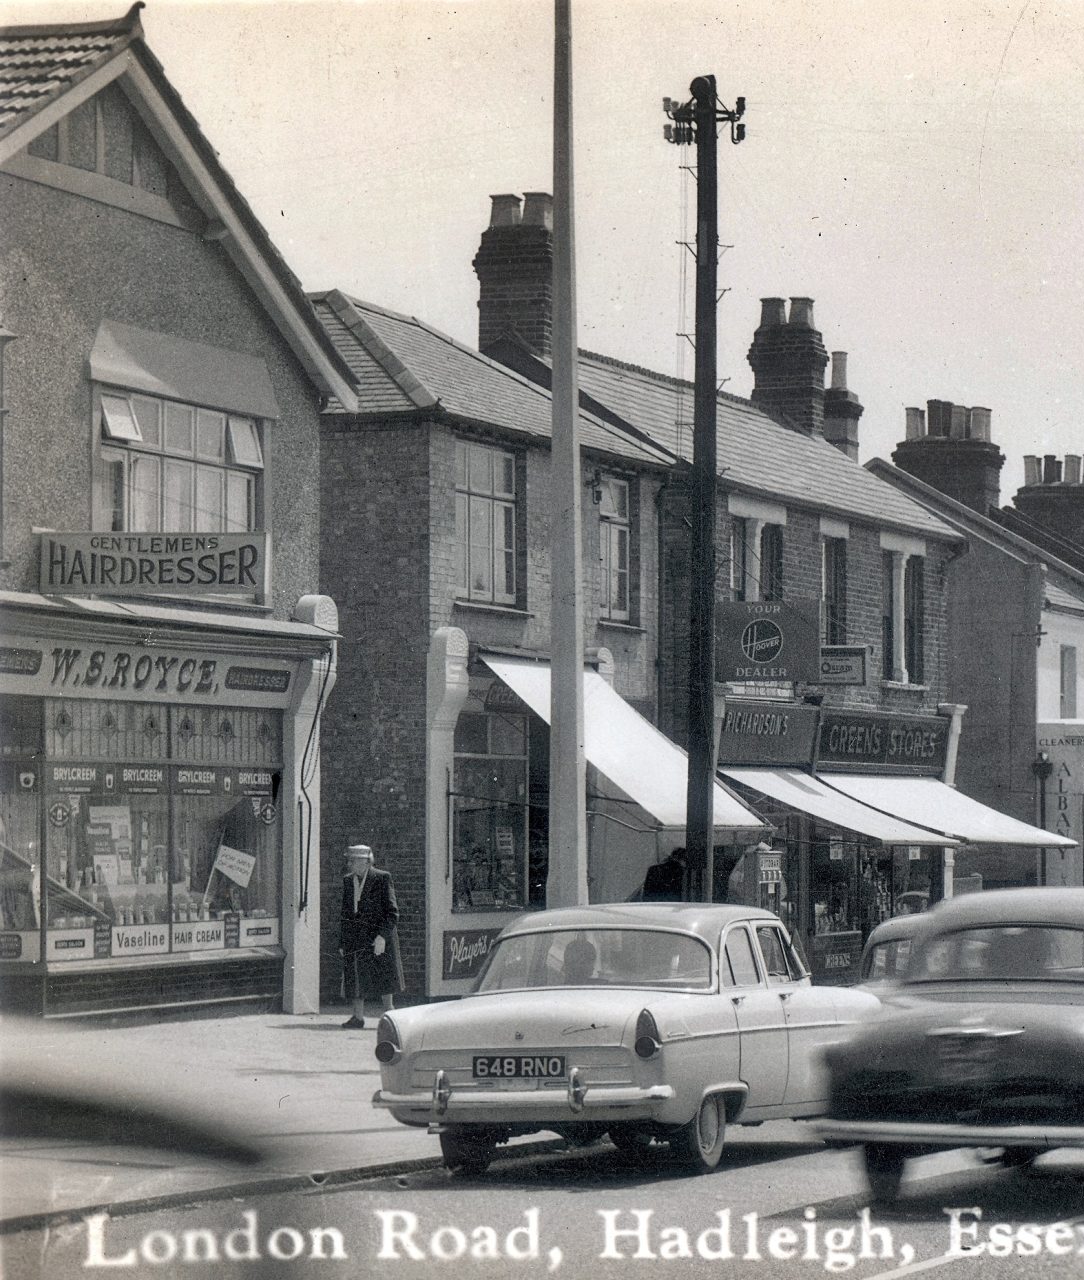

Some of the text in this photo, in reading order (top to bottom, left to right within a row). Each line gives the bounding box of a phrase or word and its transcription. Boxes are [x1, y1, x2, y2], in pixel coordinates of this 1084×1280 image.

[90, 536, 219, 553] GENTLEMENS
[49, 539, 258, 585] HAIRDRESSER
[746, 605, 781, 613] YOUR
[736, 667, 787, 676] DEALER
[888, 729, 937, 757] STORES
[53, 767, 96, 781] BRYLCREEM
[123, 768, 163, 781] BRYLCREEM
[117, 932, 165, 948] Vaseline
[174, 931, 193, 944] HAIR
[196, 930, 222, 943] CREAM
[476, 1056, 562, 1076] 648 RNO
